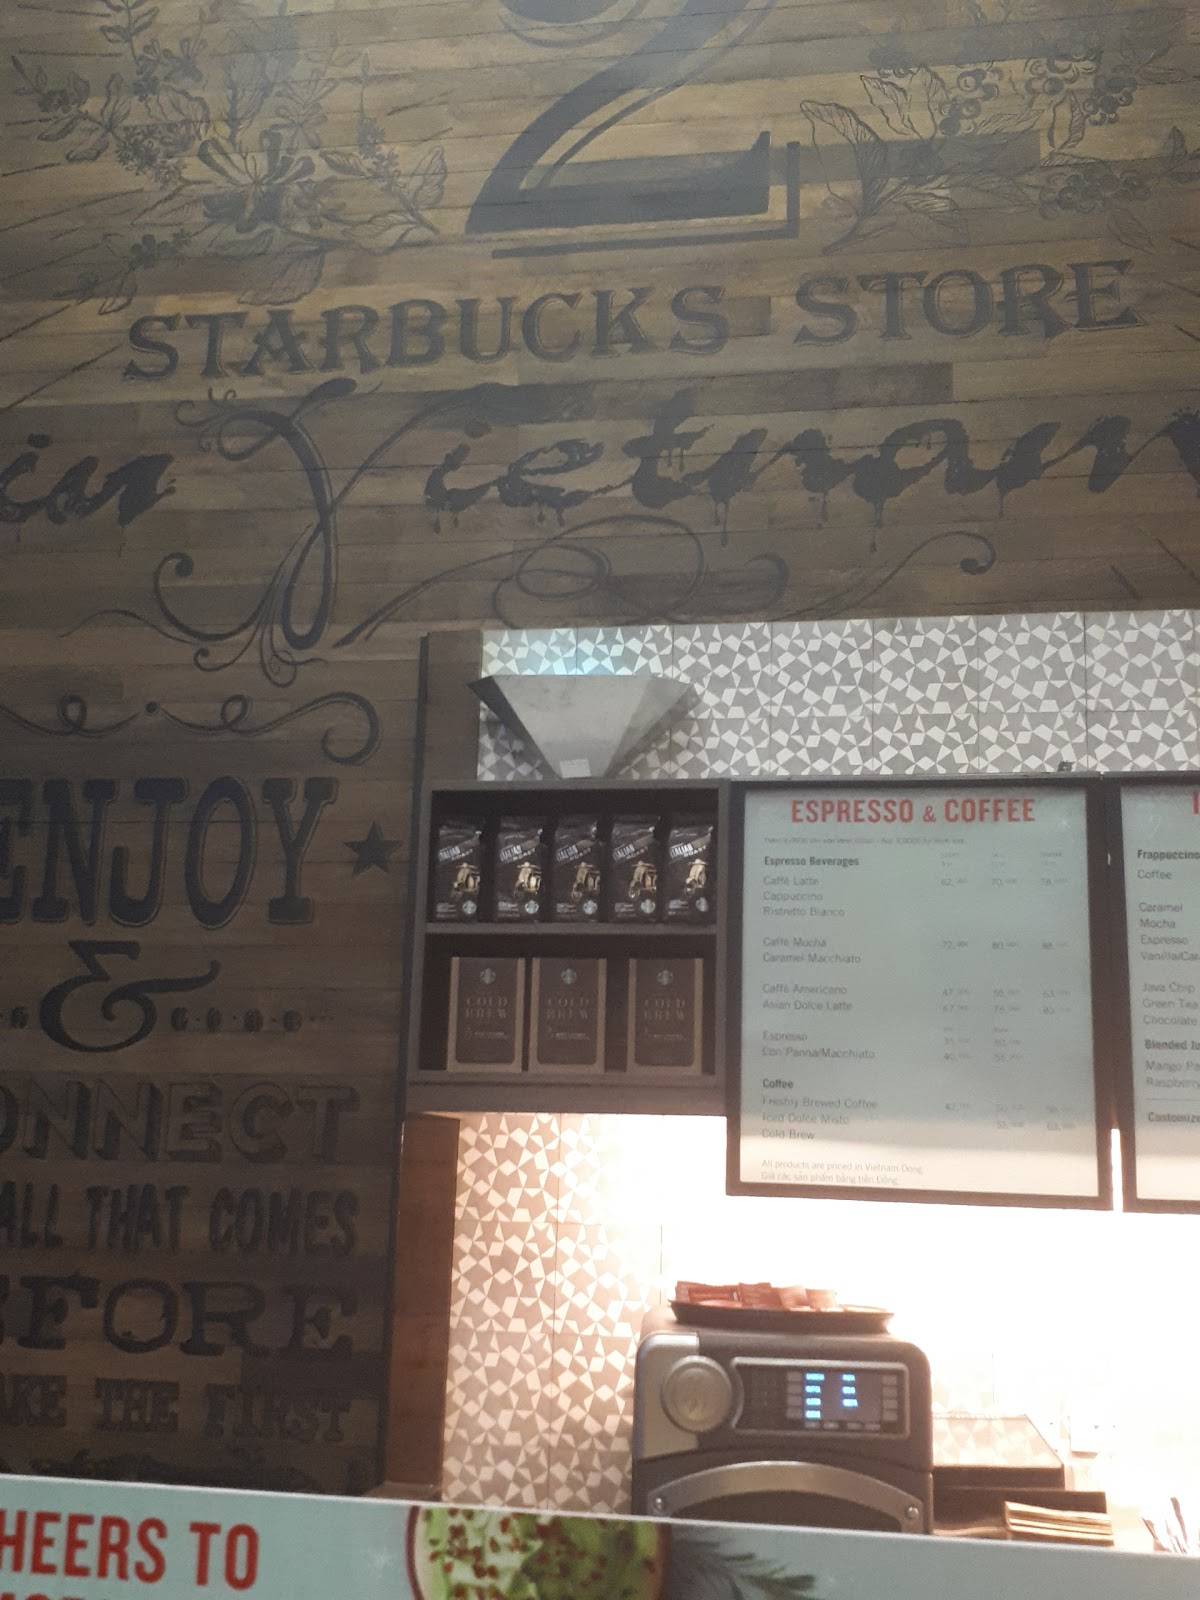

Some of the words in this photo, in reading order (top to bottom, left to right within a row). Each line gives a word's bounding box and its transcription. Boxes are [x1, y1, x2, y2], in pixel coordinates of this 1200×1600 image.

[124, 284, 727, 380] STARBUCKS
[796, 260, 1146, 342] STORE
[791, 799, 913, 823] ESPRESSO
[923, 805, 937, 823] &
[943, 798, 1035, 823] COFFEE
[764, 856, 806, 868] Espresso
[809, 856, 860, 868] Beverages
[1137, 869, 1173, 880] Coffee
[793, 876, 819, 886] Latte
[763, 891, 823, 903] Cappuccino
[763, 906, 807, 918] Ristretto
[810, 907, 845, 918] Bianco
[1139, 901, 1183, 913] Caramel
[1140, 917, 1176, 929] Mocha
[792, 937, 827, 948] Mocha
[1140, 934, 1188, 946] Espresso
[763, 952, 804, 963] Caramel
[808, 952, 861, 964] Macchiato
[792, 984, 847, 995] Americano
[1142, 982, 1166, 993] Java
[1168, 982, 1196, 995] Chip
[39, 939, 218, 1053] &
[762, 1000, 791, 1010] Asian
[794, 1000, 823, 1011] Dolce
[826, 1001, 853, 1012] Latte
[1143, 998, 1175, 1009] Green
[1179, 998, 1199, 1010] Tea
[1143, 1015, 1198, 1026] Chocolate
[762, 1030, 808, 1043] Espresso
[1144, 1039, 1188, 1051] Blended
[1145, 1060, 1182, 1073] Mango
[762, 1078, 794, 1089] Coffee
[762, 1095, 799, 1109] Freshly
[802, 1097, 840, 1109] Brewed
[843, 1098, 878, 1110] Coffee
[788, 1112, 817, 1124] Dolce
[820, 1113, 850, 1126] Misto
[761, 1127, 786, 1138] Cold
[788, 1129, 816, 1140] Brew
[761, 1160, 773, 1169] All
[775, 1160, 809, 1172] products
[865, 1163, 899, 1174] Vietnam
[86, 1183, 190, 1251] THAT
[210, 1186, 360, 1255] COMES
[0, 1275, 358, 1359] FORE
[95, 1378, 180, 1433] THE
[189, 1521, 259, 1591] TO
